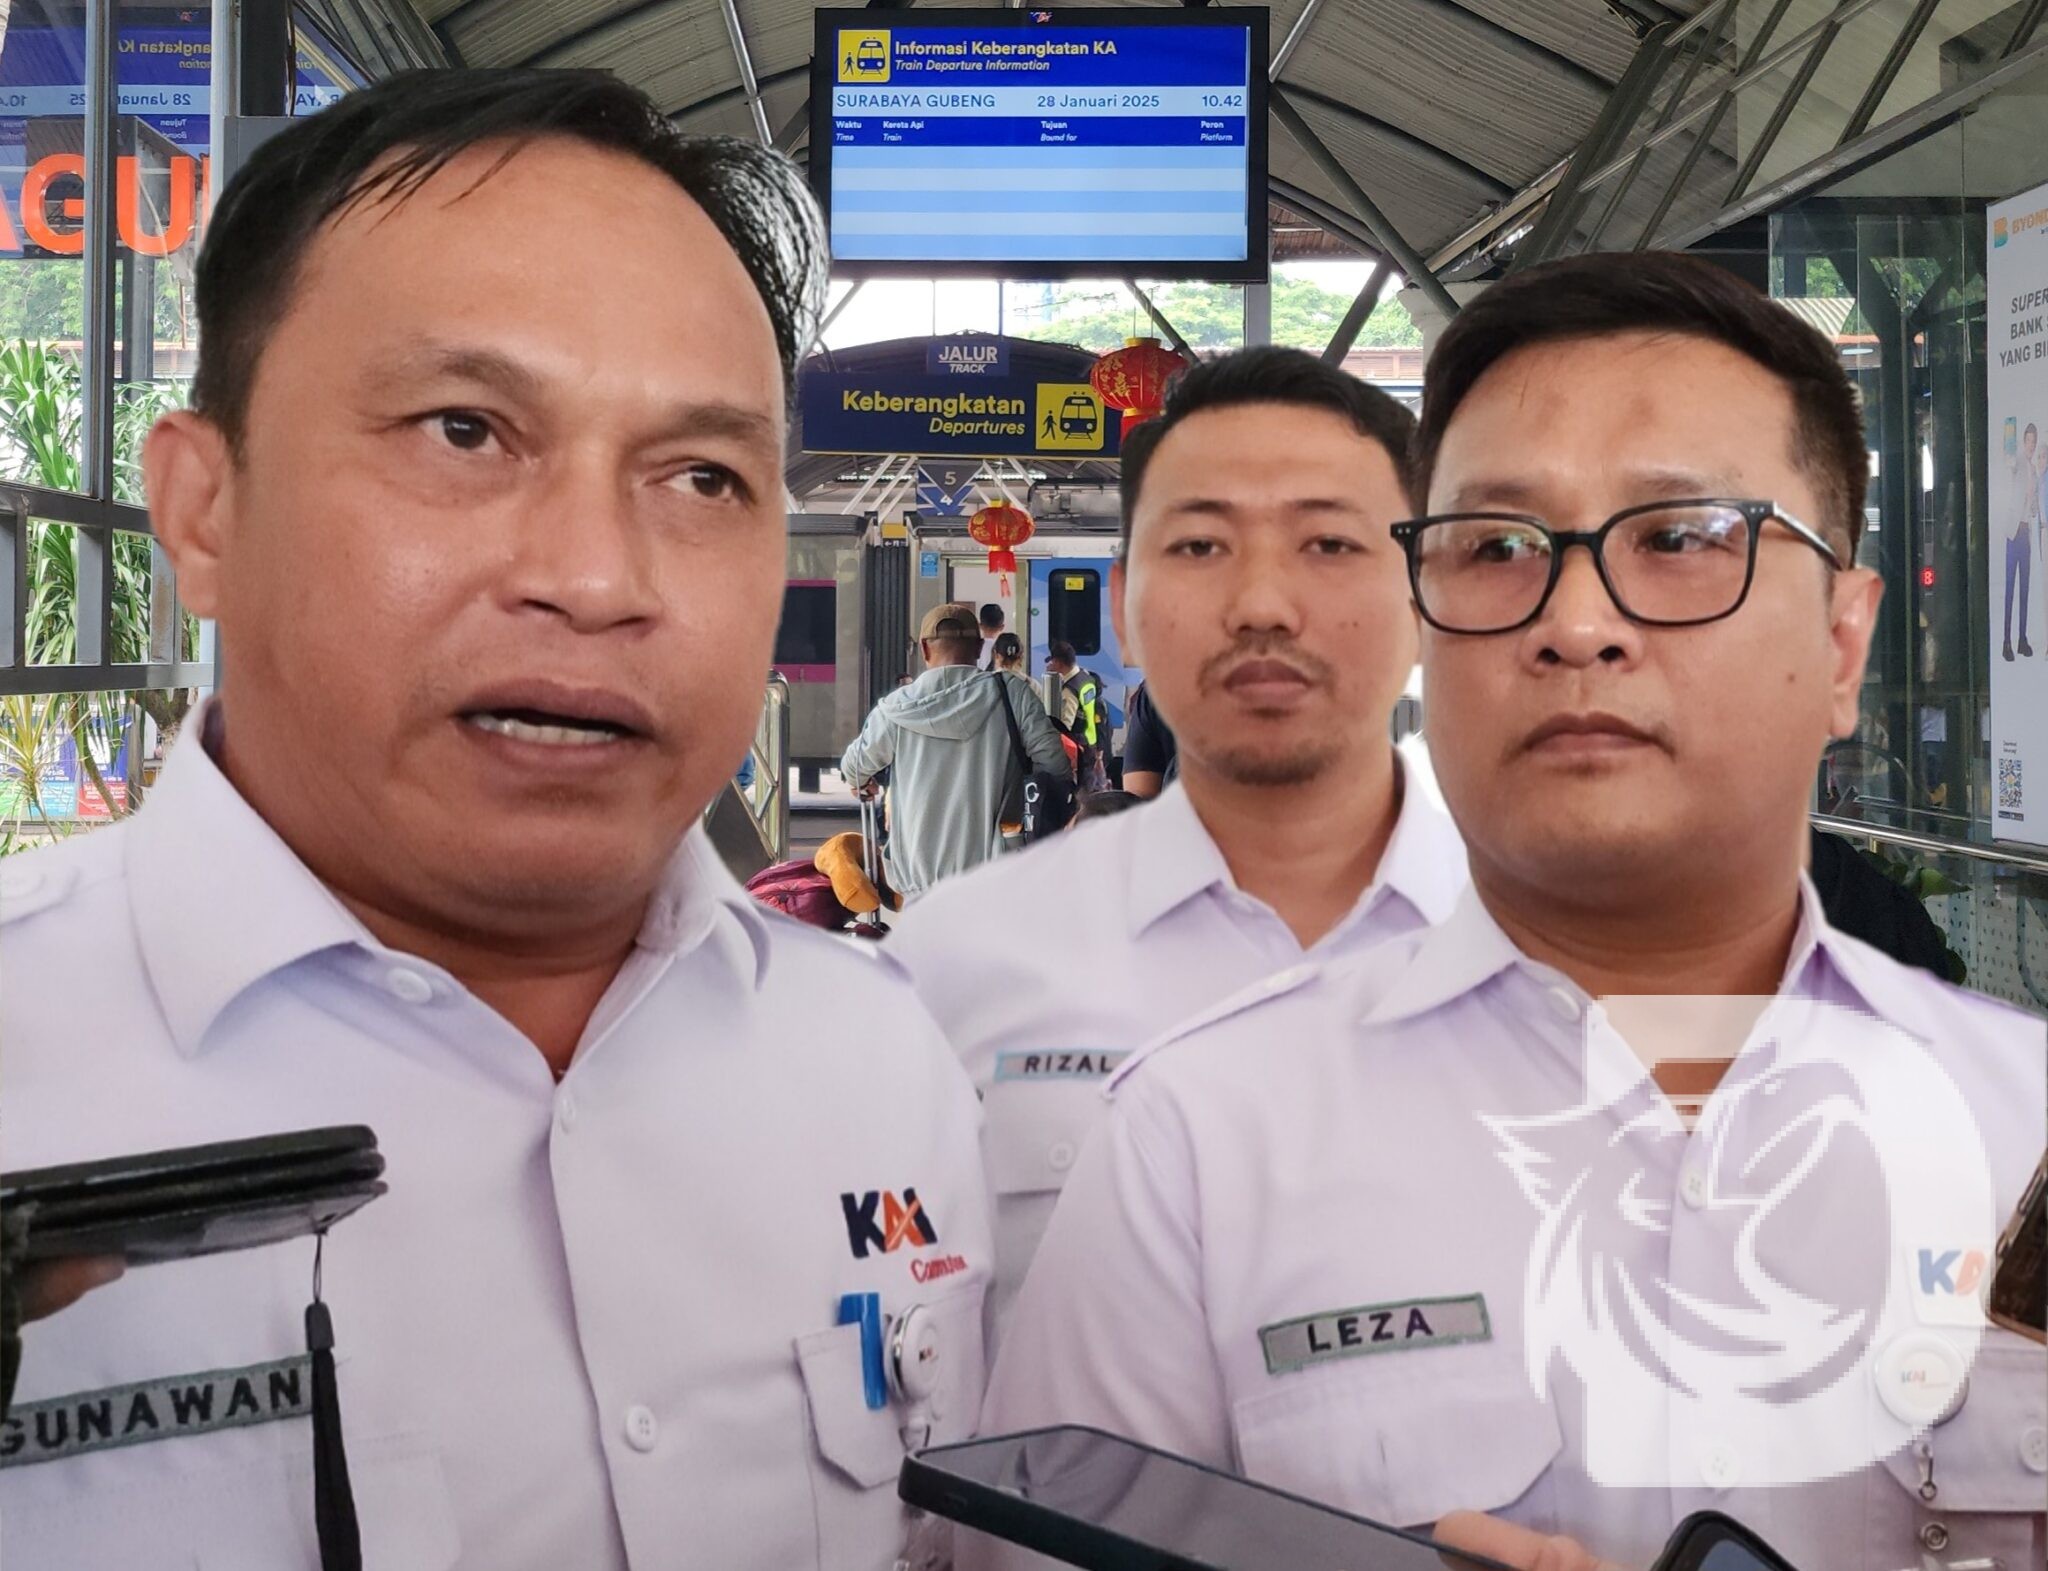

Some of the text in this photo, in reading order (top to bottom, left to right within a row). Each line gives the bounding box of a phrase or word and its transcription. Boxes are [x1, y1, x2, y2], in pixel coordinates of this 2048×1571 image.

[895, 41, 1117, 58] Informasi Keberangkatan KA
[895, 60, 1050, 73] Train Departure Information
[836, 94, 996, 108] SURABAYA GUBENG
[1037, 94, 1160, 108] 28 Januari 2025
[1201, 94, 1243, 107] 10.42
[835, 120, 863, 129] Waktu
[910, 120, 925, 131] Api
[1041, 120, 1068, 131] Tujuan
[1200, 120, 1224, 129] Peron
[836, 132, 855, 141] Time
[883, 132, 903, 141] Train
[1040, 132, 1078, 142] Bound for
[1200, 132, 1234, 142] Platform
[2010, 316, 2043, 340] BANK
[938, 346, 998, 362] JALUR
[2000, 340, 2048, 369] YANG BI
[950, 363, 986, 374] TRACK
[843, 390, 1026, 418] Keberangkatan
[929, 417, 1026, 437] Departures
[944, 471, 957, 486] 5
[1023, 1055, 1114, 1074] RIZAL
[840, 1187, 938, 1259] KAI
[1307, 1307, 1434, 1354] LEZA
[0, 1368, 302, 1455] GUNAWAN
